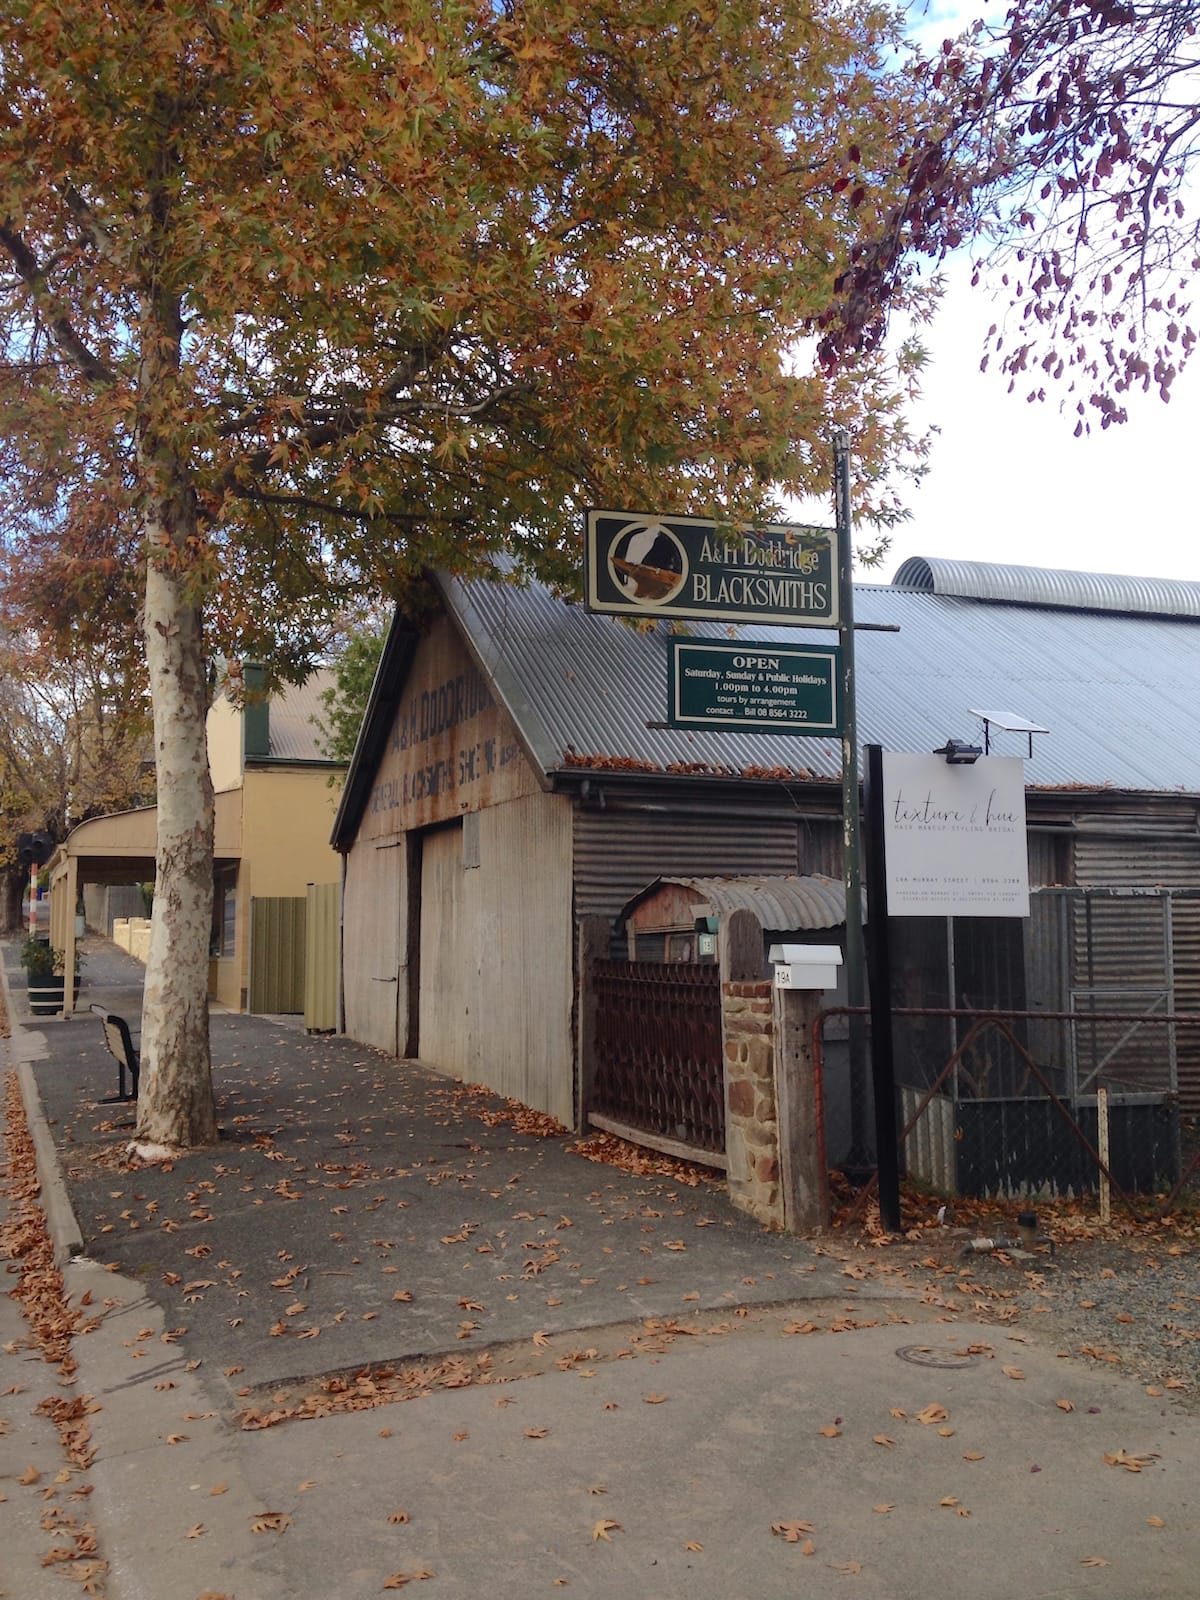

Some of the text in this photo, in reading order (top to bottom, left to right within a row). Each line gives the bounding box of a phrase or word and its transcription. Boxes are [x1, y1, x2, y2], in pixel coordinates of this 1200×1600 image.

[692, 573, 827, 609] BLACKSMITHS
[732, 656, 780, 670] OPEN
[725, 670, 756, 682] Sunday
[758, 673, 764, 681] &
[766, 673, 791, 683] Public
[792, 674, 827, 686] Holidays
[715, 682, 798, 696] 1.00pm to 4.00pm
[717, 695, 796, 708] tours by arrangement
[705, 707, 734, 715] contact
[744, 707, 756, 716] Bill
[757, 708, 767, 717] 08
[768, 709, 788, 718] 8564
[789, 710, 808, 719] 3222
[892, 788, 963, 824] texture
[984, 788, 1020, 827] hue
[951, 825, 984, 833] STYLING
